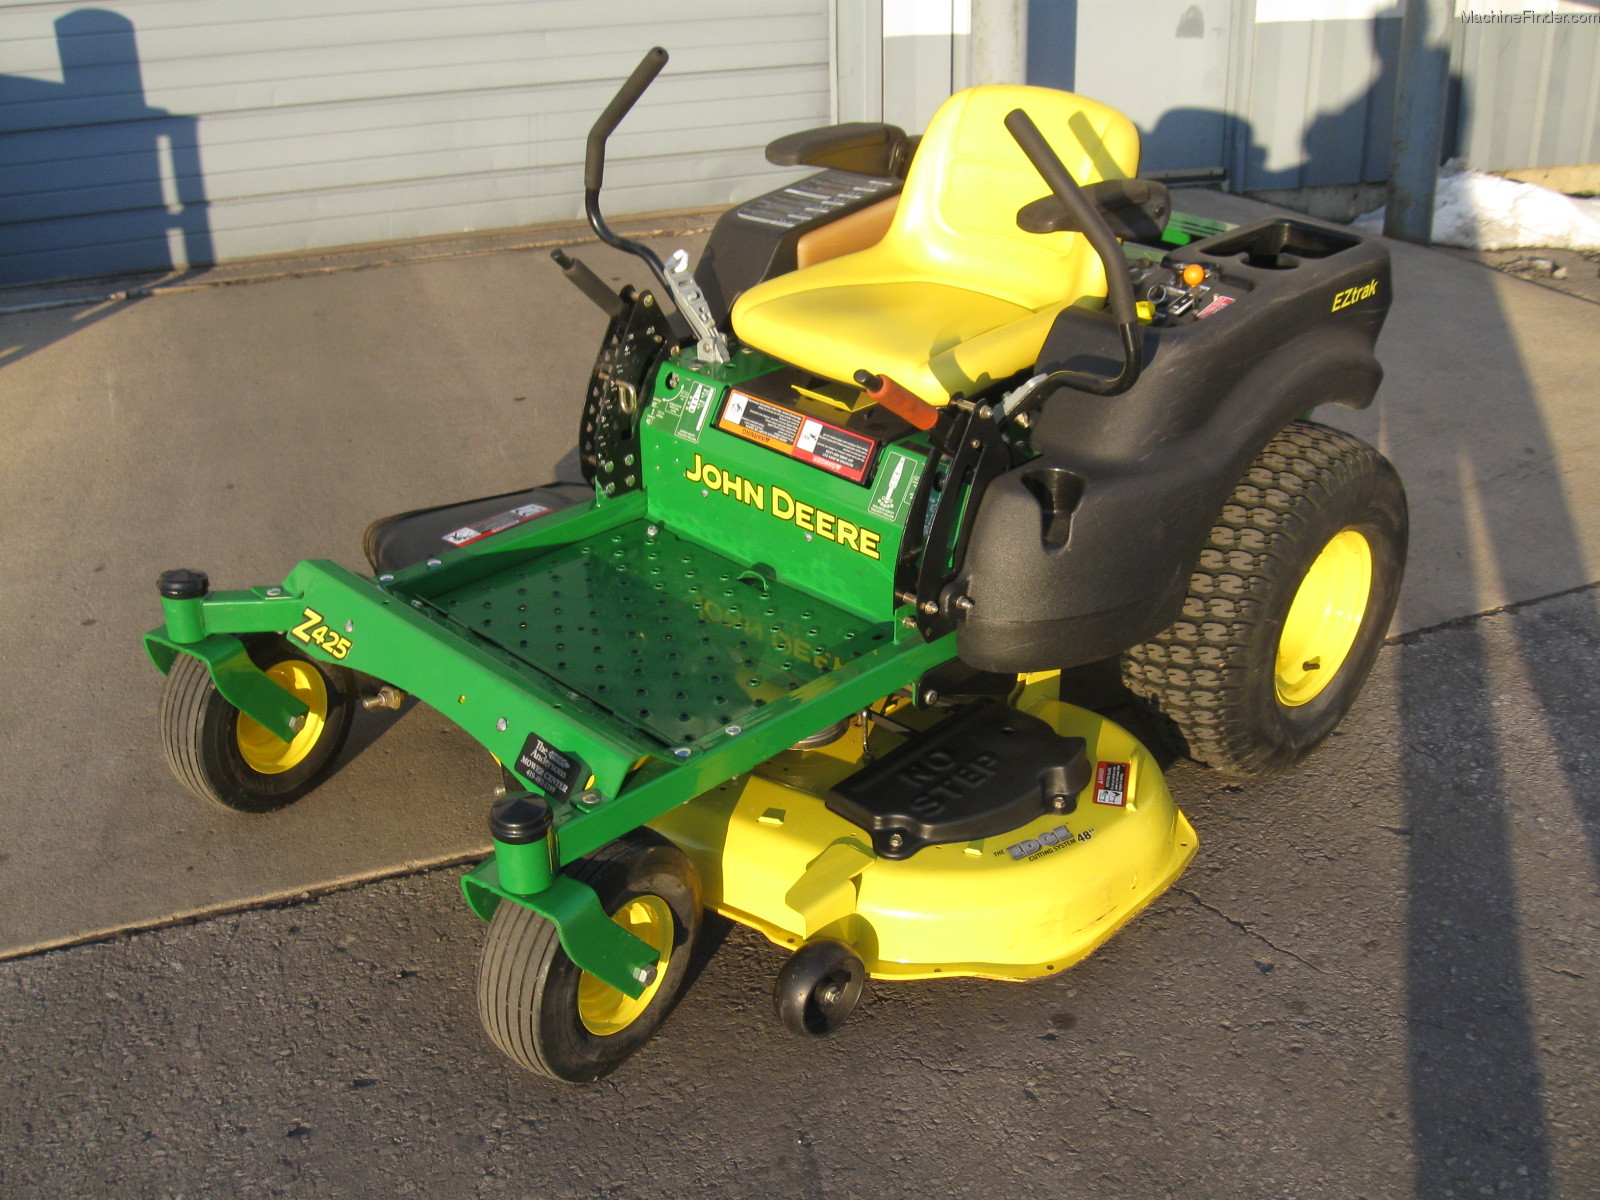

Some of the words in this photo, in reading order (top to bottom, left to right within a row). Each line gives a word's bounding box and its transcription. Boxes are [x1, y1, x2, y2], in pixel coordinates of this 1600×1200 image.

[1331, 278, 1379, 313] EZtrak
[812, 455, 837, 469] DANGER
[686, 453, 764, 511] JOHN
[771, 485, 881, 561] DEERE
[291, 607, 353, 660] Z425
[530, 748, 567, 779] Andersons
[535, 739, 549, 755] The
[520, 754, 545, 777] MOWER
[543, 770, 569, 794] CENTER
[897, 750, 956, 788] NO
[910, 754, 997, 818] STEP
[993, 848, 1005, 857] THE
[1007, 824, 1073, 861] EDGE
[1028, 848, 1054, 862] CUTTING
[1053, 838, 1077, 852] SYSTEM
[1077, 828, 1095, 842] 48"
